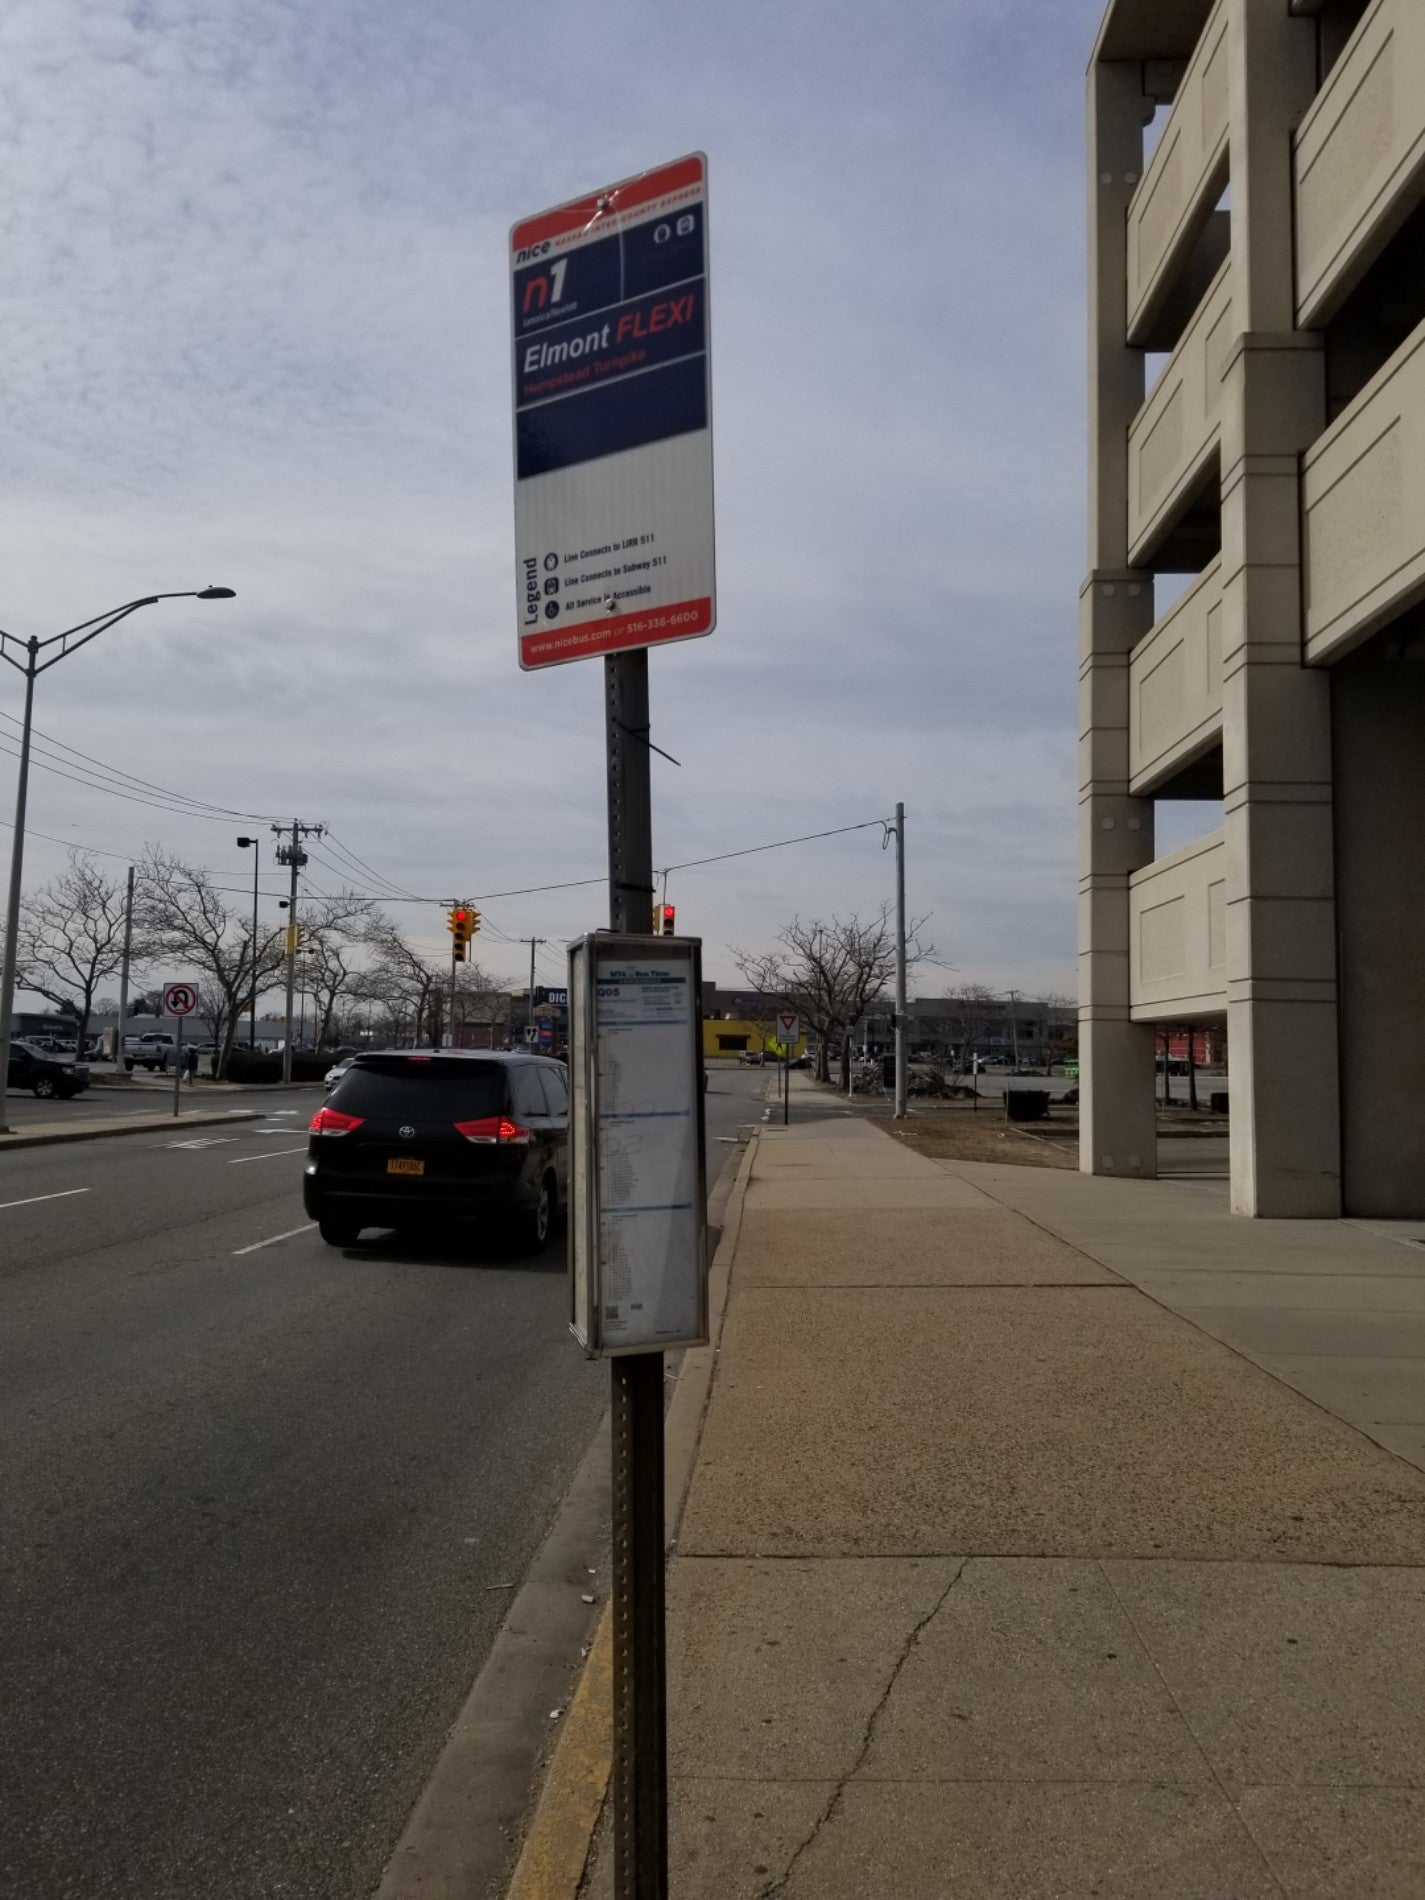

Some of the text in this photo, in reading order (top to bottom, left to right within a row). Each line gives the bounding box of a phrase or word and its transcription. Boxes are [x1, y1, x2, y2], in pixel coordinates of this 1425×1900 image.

[516, 240, 550, 264] nice
[523, 259, 568, 313] n1
[524, 294, 695, 373] Elmont FLEXI
[564, 554, 579, 563] Line
[580, 546, 611, 558] Connects
[640, 534, 655, 545] 511
[564, 556, 667, 587] Line Connects to Subway 511
[523, 557, 541, 625] Legend
[565, 602, 575, 611] All
[576, 596, 603, 609] Service
[612, 585, 651, 600] Accessible
[530, 629, 612, 654] www.nicebus.com
[626, 610, 698, 634] 516-336-6600
[549, 993, 567, 1004] DIC
